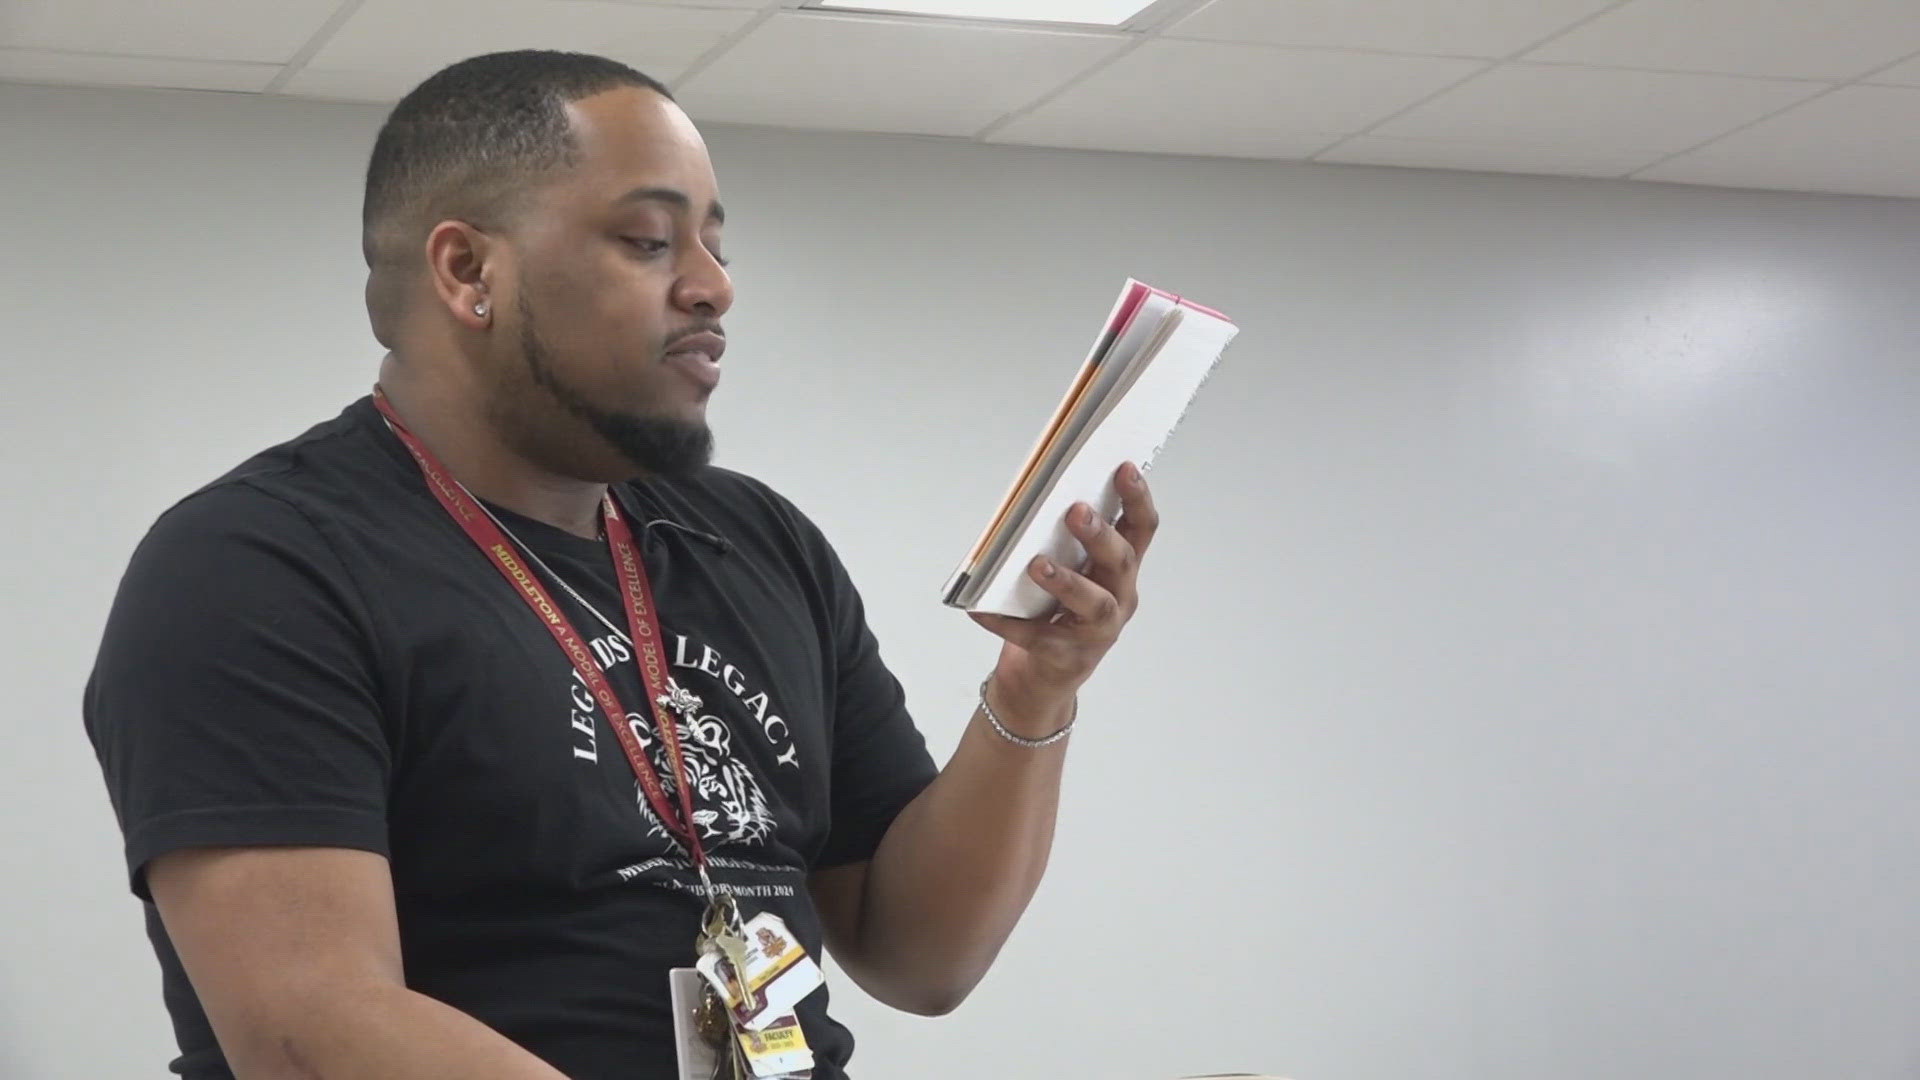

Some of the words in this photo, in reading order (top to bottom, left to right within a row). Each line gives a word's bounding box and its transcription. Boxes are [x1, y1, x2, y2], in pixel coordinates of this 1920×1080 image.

[617, 542, 647, 616] EXCELLENCE
[636, 619, 652, 637] OF
[491, 543, 561, 625] MIDDLETON
[557, 626, 567, 636] A
[565, 637, 600, 686] MODEL
[598, 689, 615, 708] OF
[611, 711, 661, 801] EXCELLENCE
[642, 642, 662, 690] MODEL
[674, 634, 799, 769] LEGACY
[733, 884, 772, 898] MONTH
[773, 884, 795, 897] 2024
[764, 1028, 793, 1042] FACULTY
